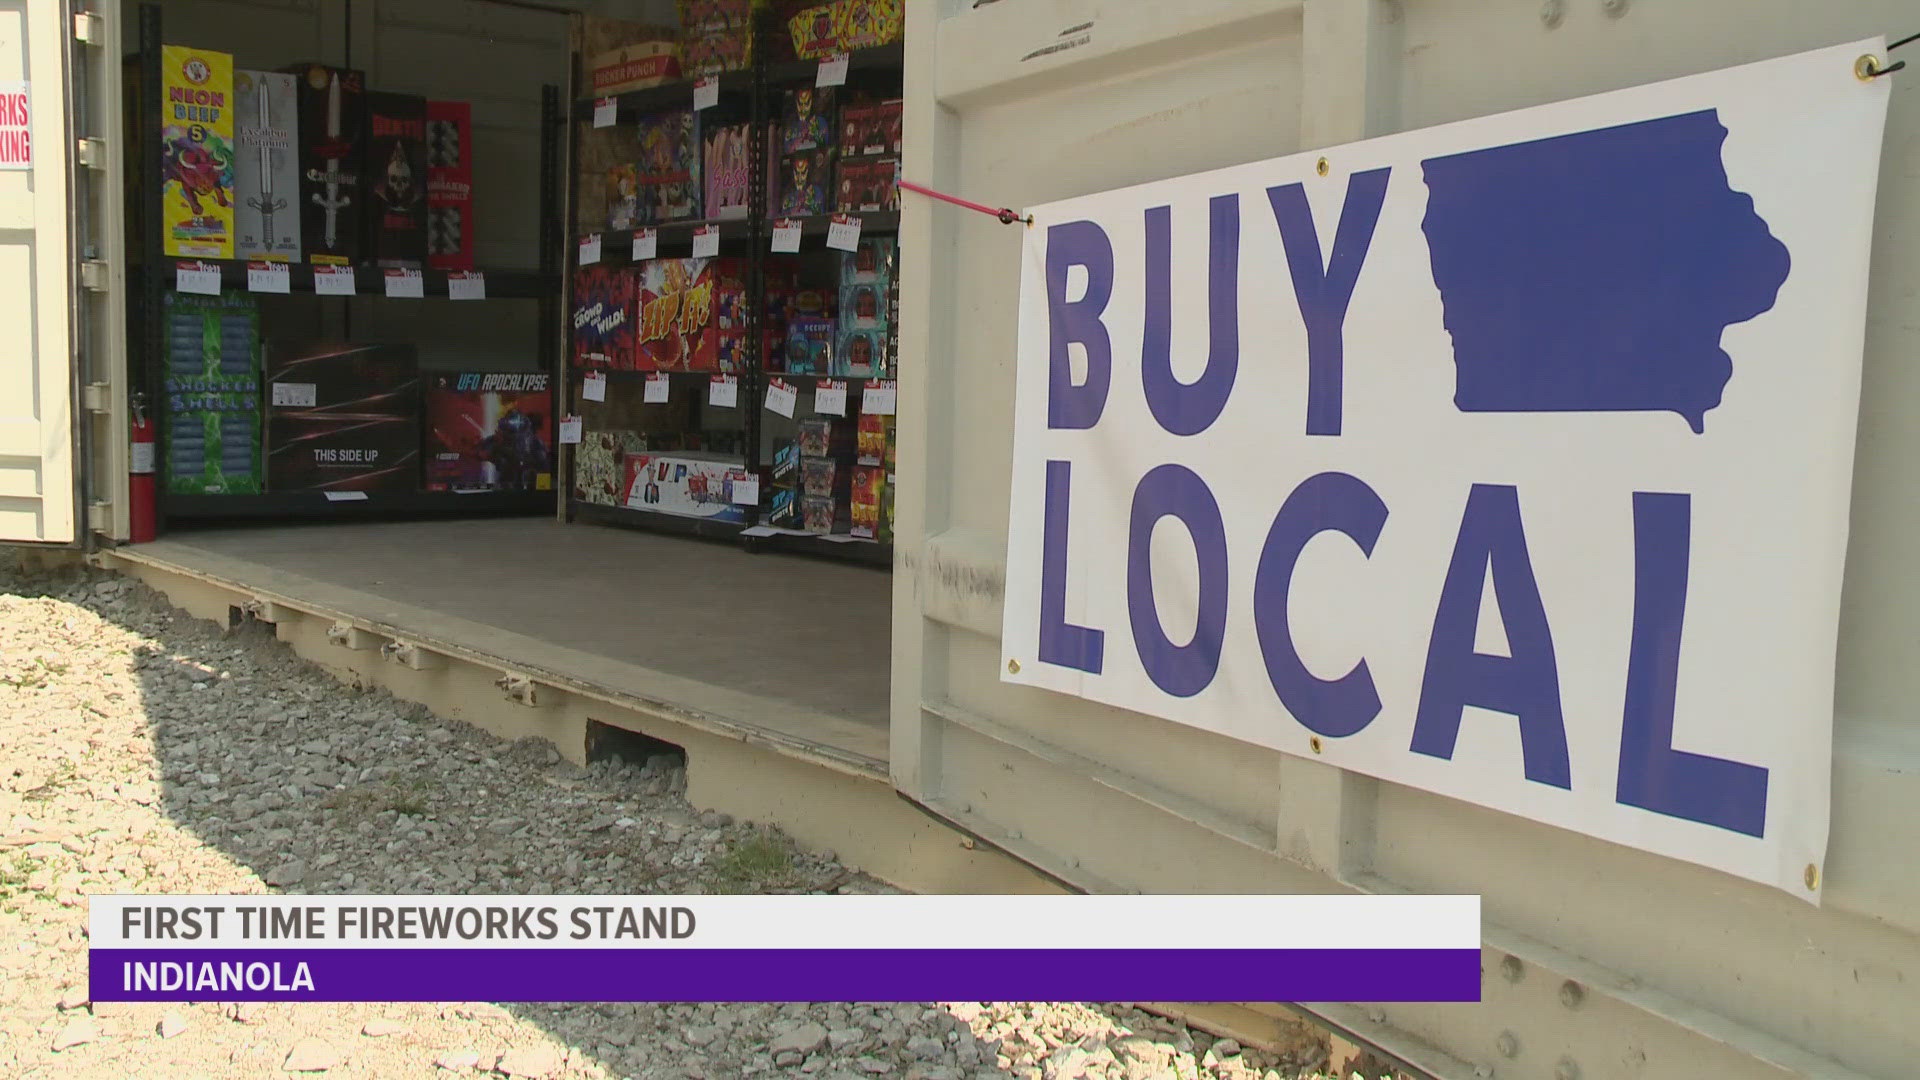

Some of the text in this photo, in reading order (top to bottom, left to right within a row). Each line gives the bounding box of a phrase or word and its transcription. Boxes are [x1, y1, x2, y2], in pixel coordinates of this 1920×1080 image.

[626, 61, 656, 79] PUNCH
[169, 86, 225, 108] NEON
[174, 104, 220, 123] BEEF
[191, 126, 203, 143] 5
[1045, 166, 1392, 436] BUY
[574, 302, 603, 329] CROWD
[596, 307, 625, 335] WILD!
[457, 373, 549, 391] UFO APOCALYPSE
[314, 449, 379, 462] THIS SIDE UP
[657, 462, 687, 483] VIP
[1038, 460, 1769, 840] LOCAL
